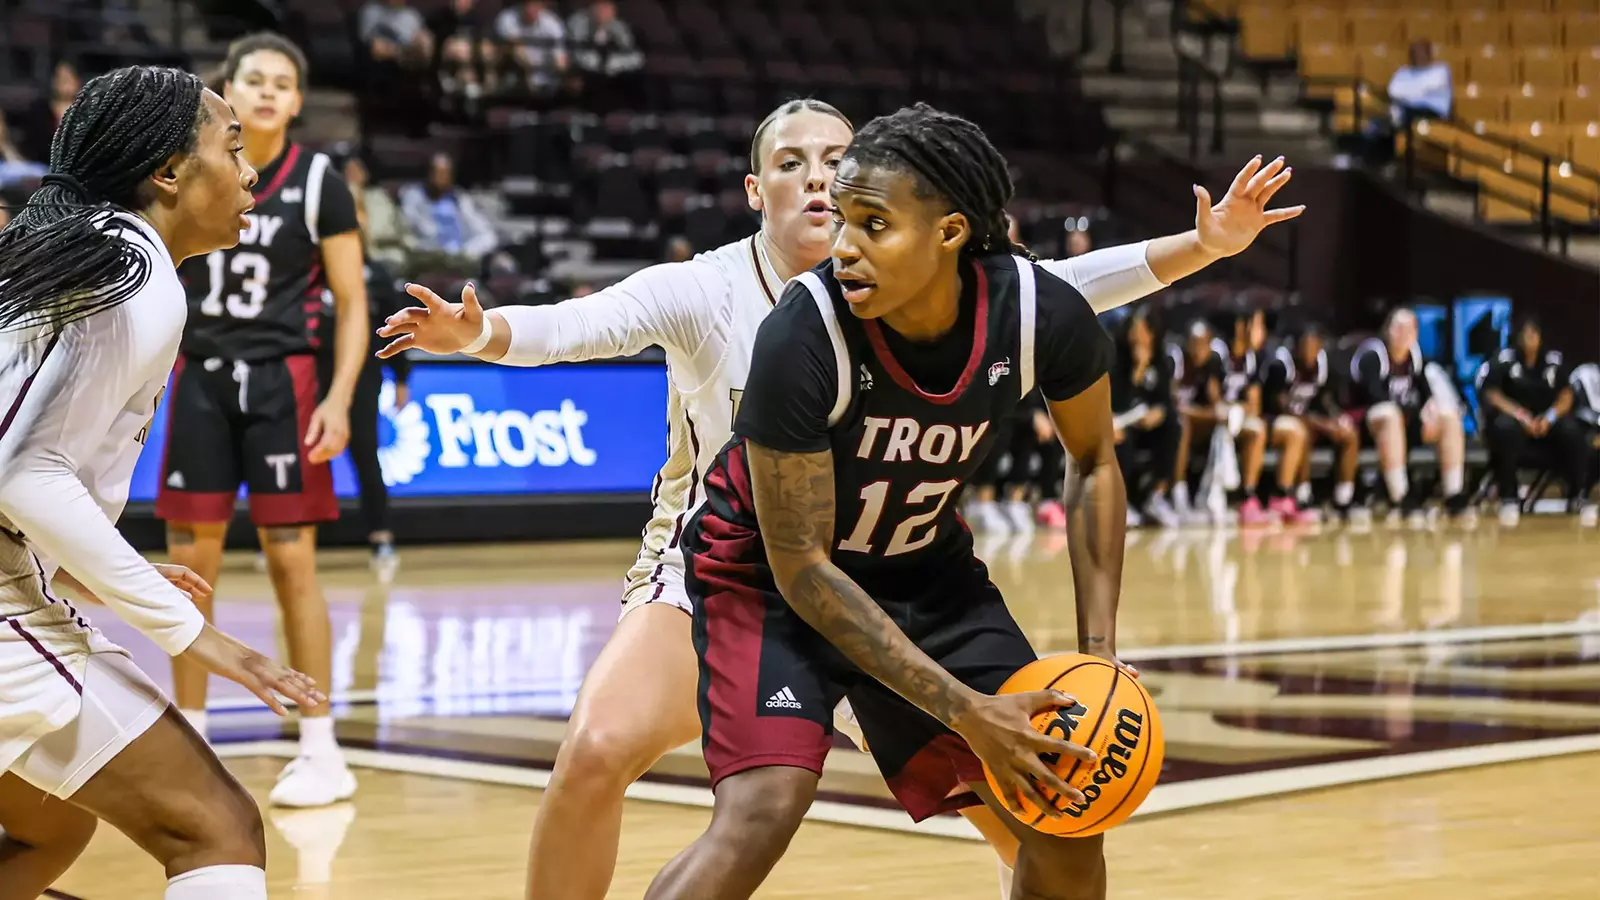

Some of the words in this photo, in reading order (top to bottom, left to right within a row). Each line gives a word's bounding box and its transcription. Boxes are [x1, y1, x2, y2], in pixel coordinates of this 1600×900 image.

[239, 213, 283, 247] OY
[200, 249, 271, 319] 13
[425, 393, 597, 467] Frost
[856, 416, 990, 464] TROY
[264, 453, 297, 490] T
[837, 478, 960, 557] 12
[765, 699, 802, 709] adidas
[1061, 708, 1143, 818] Wilson
